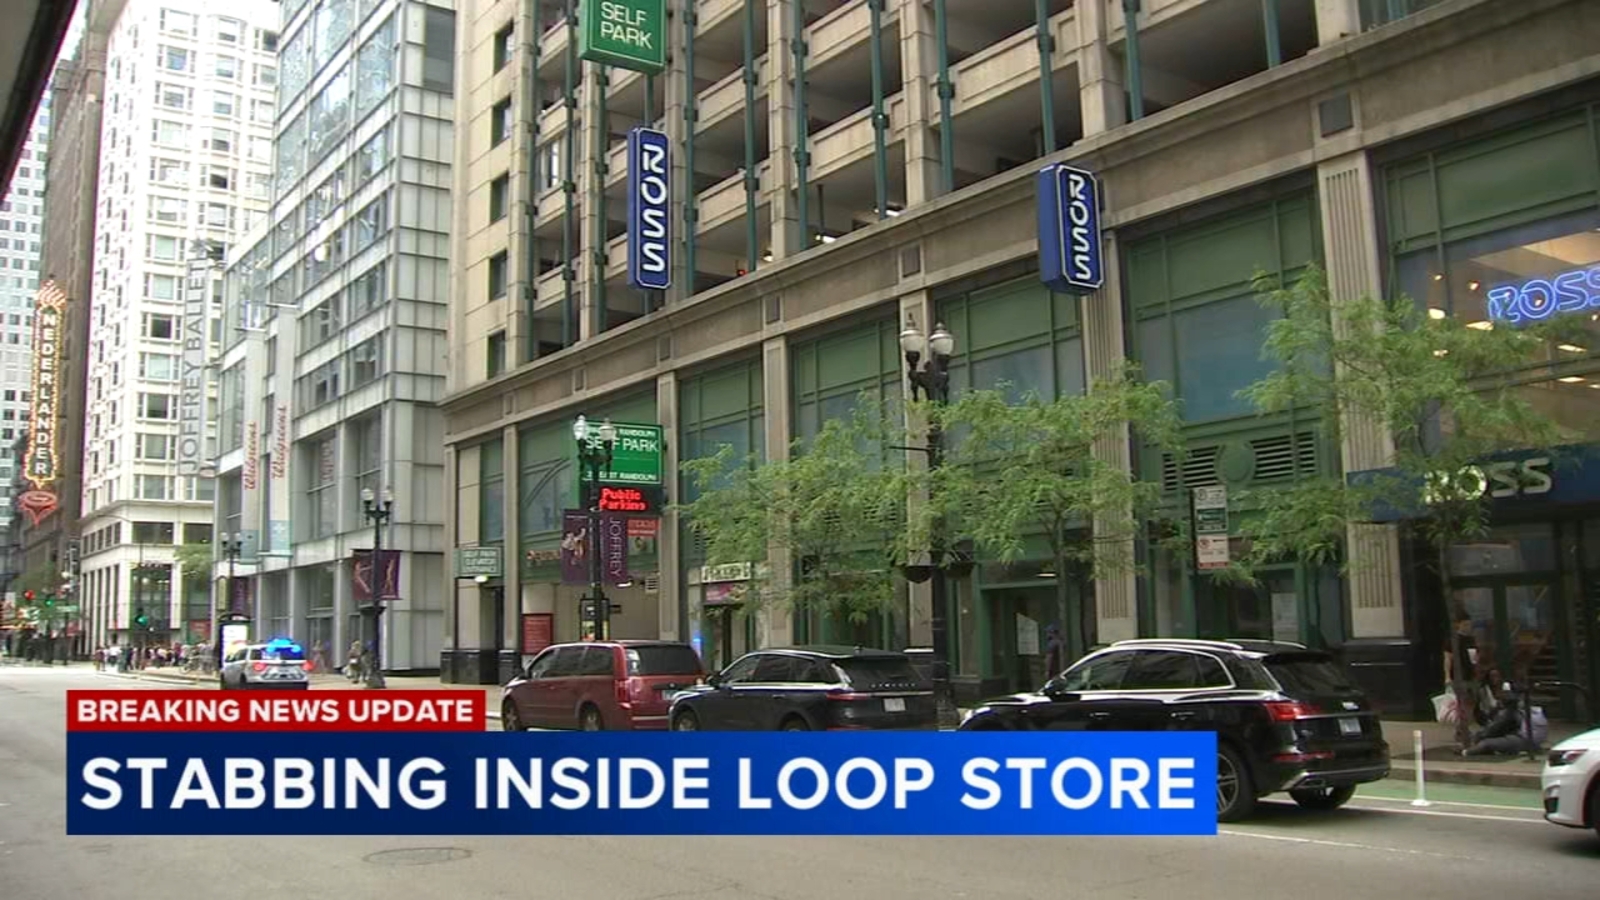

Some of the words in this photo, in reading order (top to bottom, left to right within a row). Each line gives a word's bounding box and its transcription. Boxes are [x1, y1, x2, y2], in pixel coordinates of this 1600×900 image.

[600, 2, 647, 26] SELF
[601, 21, 652, 49] PARK
[641, 144, 667, 272] ROSS
[1068, 174, 1091, 280] ROSS
[185, 262, 206, 351] BALLET
[35, 313, 57, 475] NEDERLANDER
[181, 360, 200, 473] JOFFREY
[585, 435, 620, 451] SEF
[622, 438, 659, 453] PARK
[602, 488, 642, 500] Public
[609, 516, 622, 578] JOFFREY
